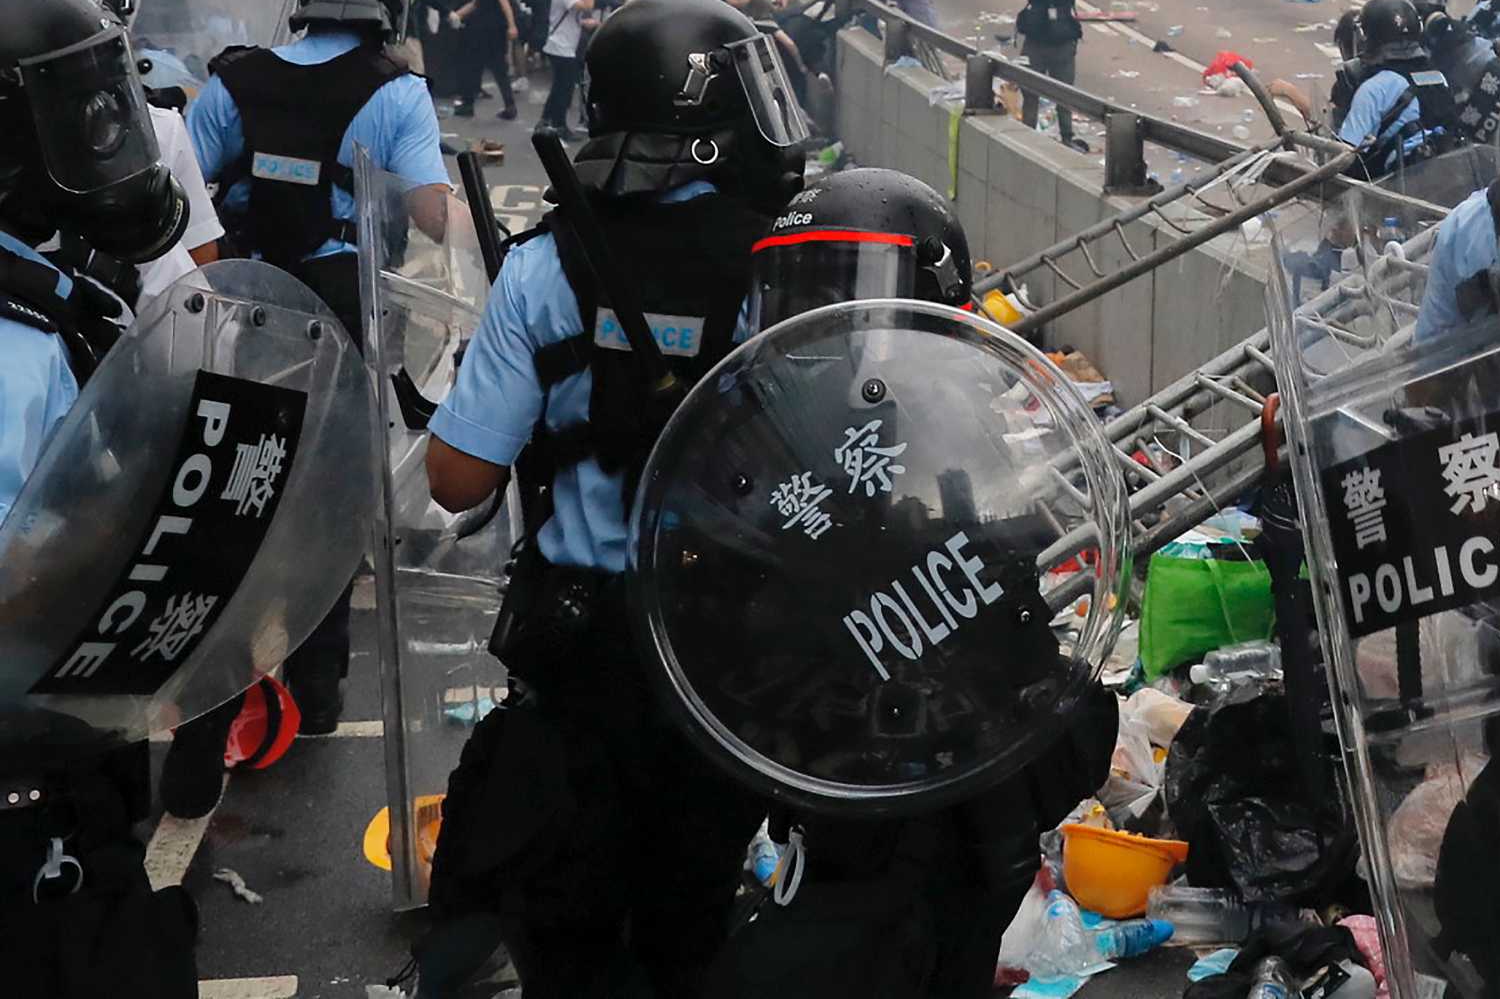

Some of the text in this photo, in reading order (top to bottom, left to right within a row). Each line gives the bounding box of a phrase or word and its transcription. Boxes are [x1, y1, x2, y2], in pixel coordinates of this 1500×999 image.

[772, 211, 813, 232] Police
[54, 399, 232, 679] POLICE
[843, 530, 1005, 682] POLICE
